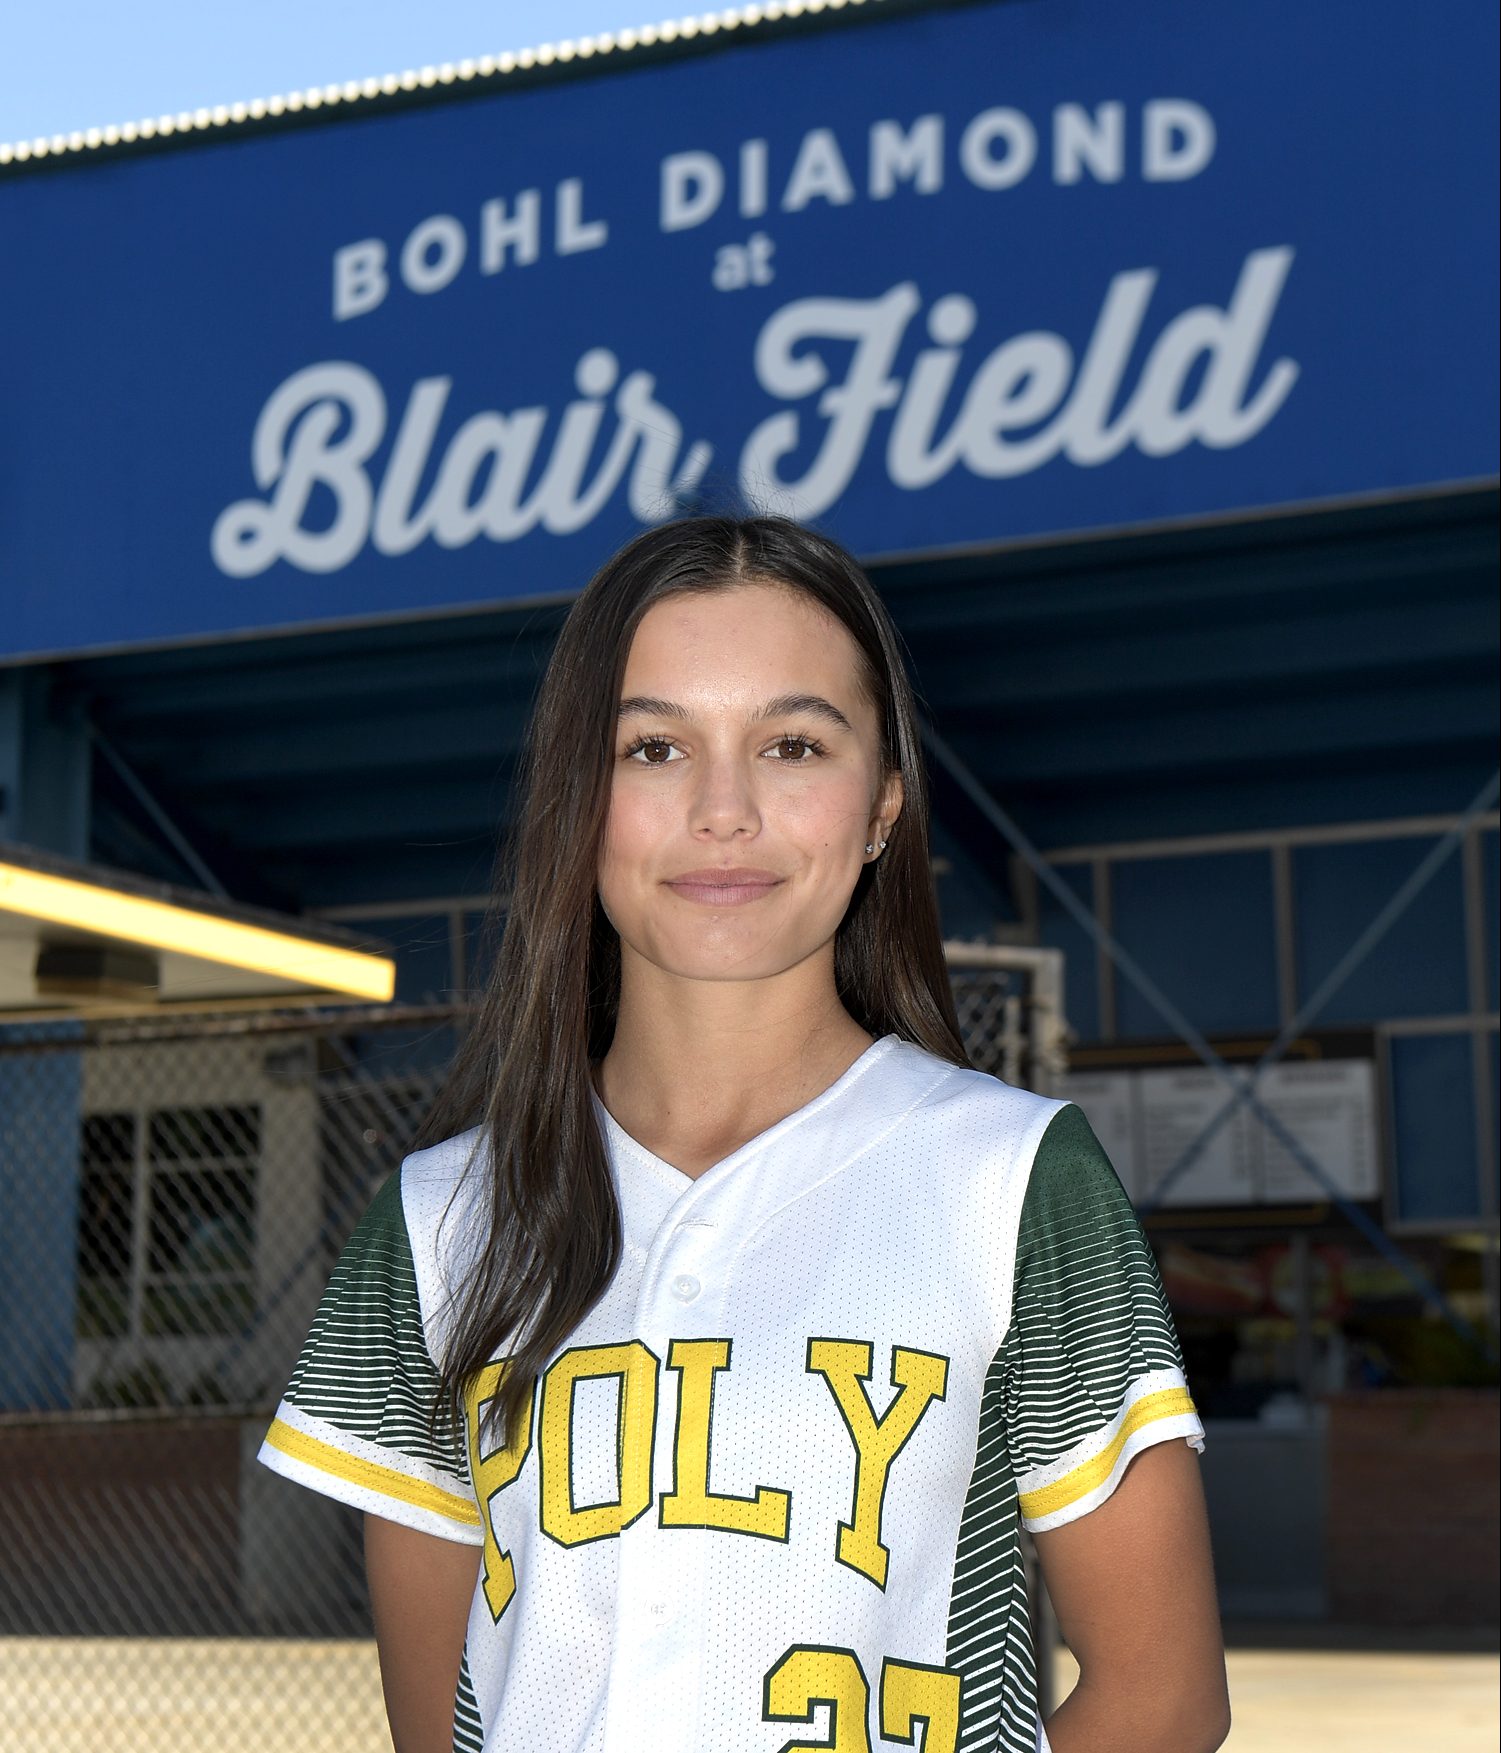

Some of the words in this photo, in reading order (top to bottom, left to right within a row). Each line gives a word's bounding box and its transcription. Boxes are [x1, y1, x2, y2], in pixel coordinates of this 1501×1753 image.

[332, 179, 608, 321] BOHL
[659, 99, 1216, 232] DIAMOND
[713, 234, 773, 291] at
[210, 347, 713, 579] Blair
[738, 246, 1299, 525] Field
[463, 1337, 950, 1627] POLY
